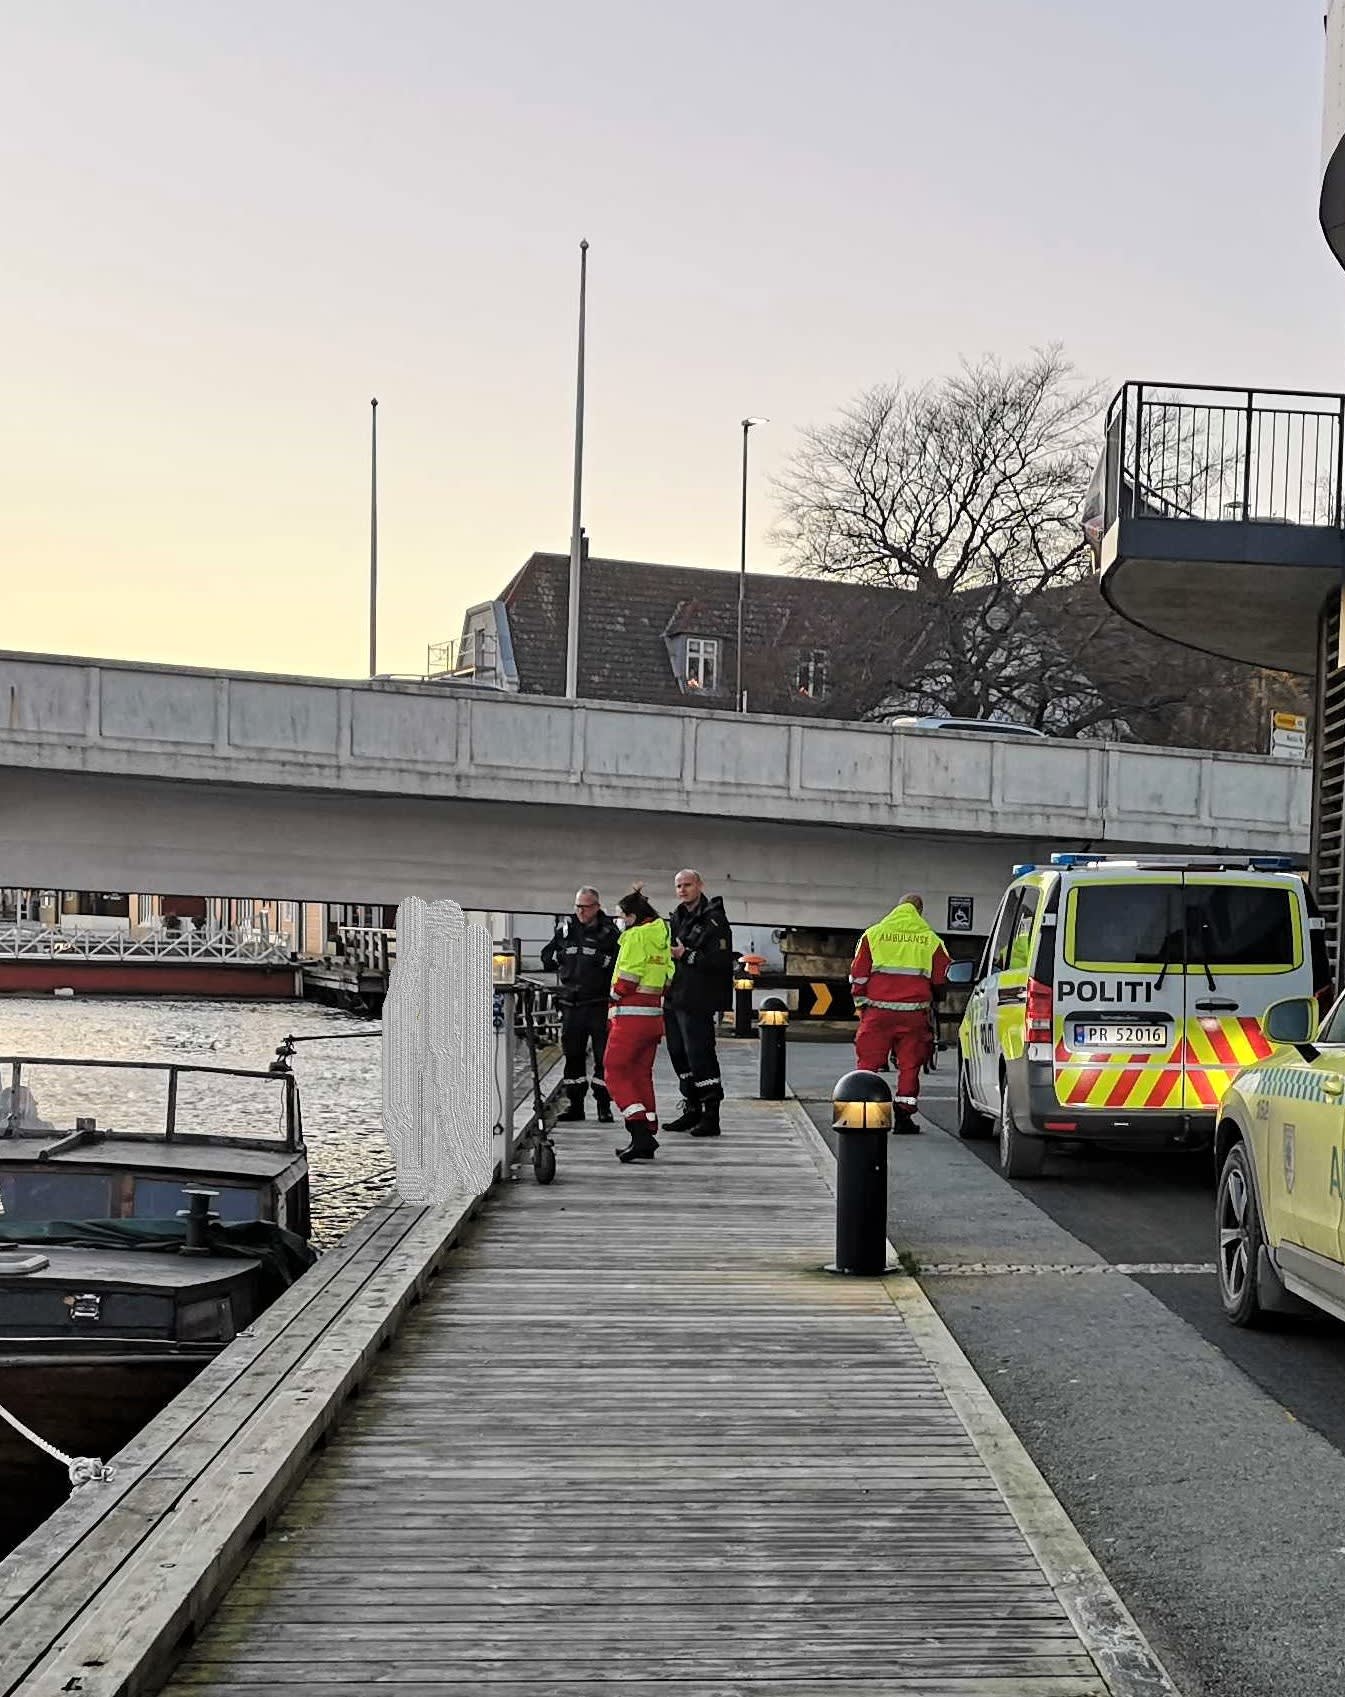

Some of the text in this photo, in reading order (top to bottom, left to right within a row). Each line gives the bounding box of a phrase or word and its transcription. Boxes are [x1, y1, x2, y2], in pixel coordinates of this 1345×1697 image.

[1057, 980, 1152, 1003] POLITI
[1089, 1027, 1161, 1042] PR 52016
